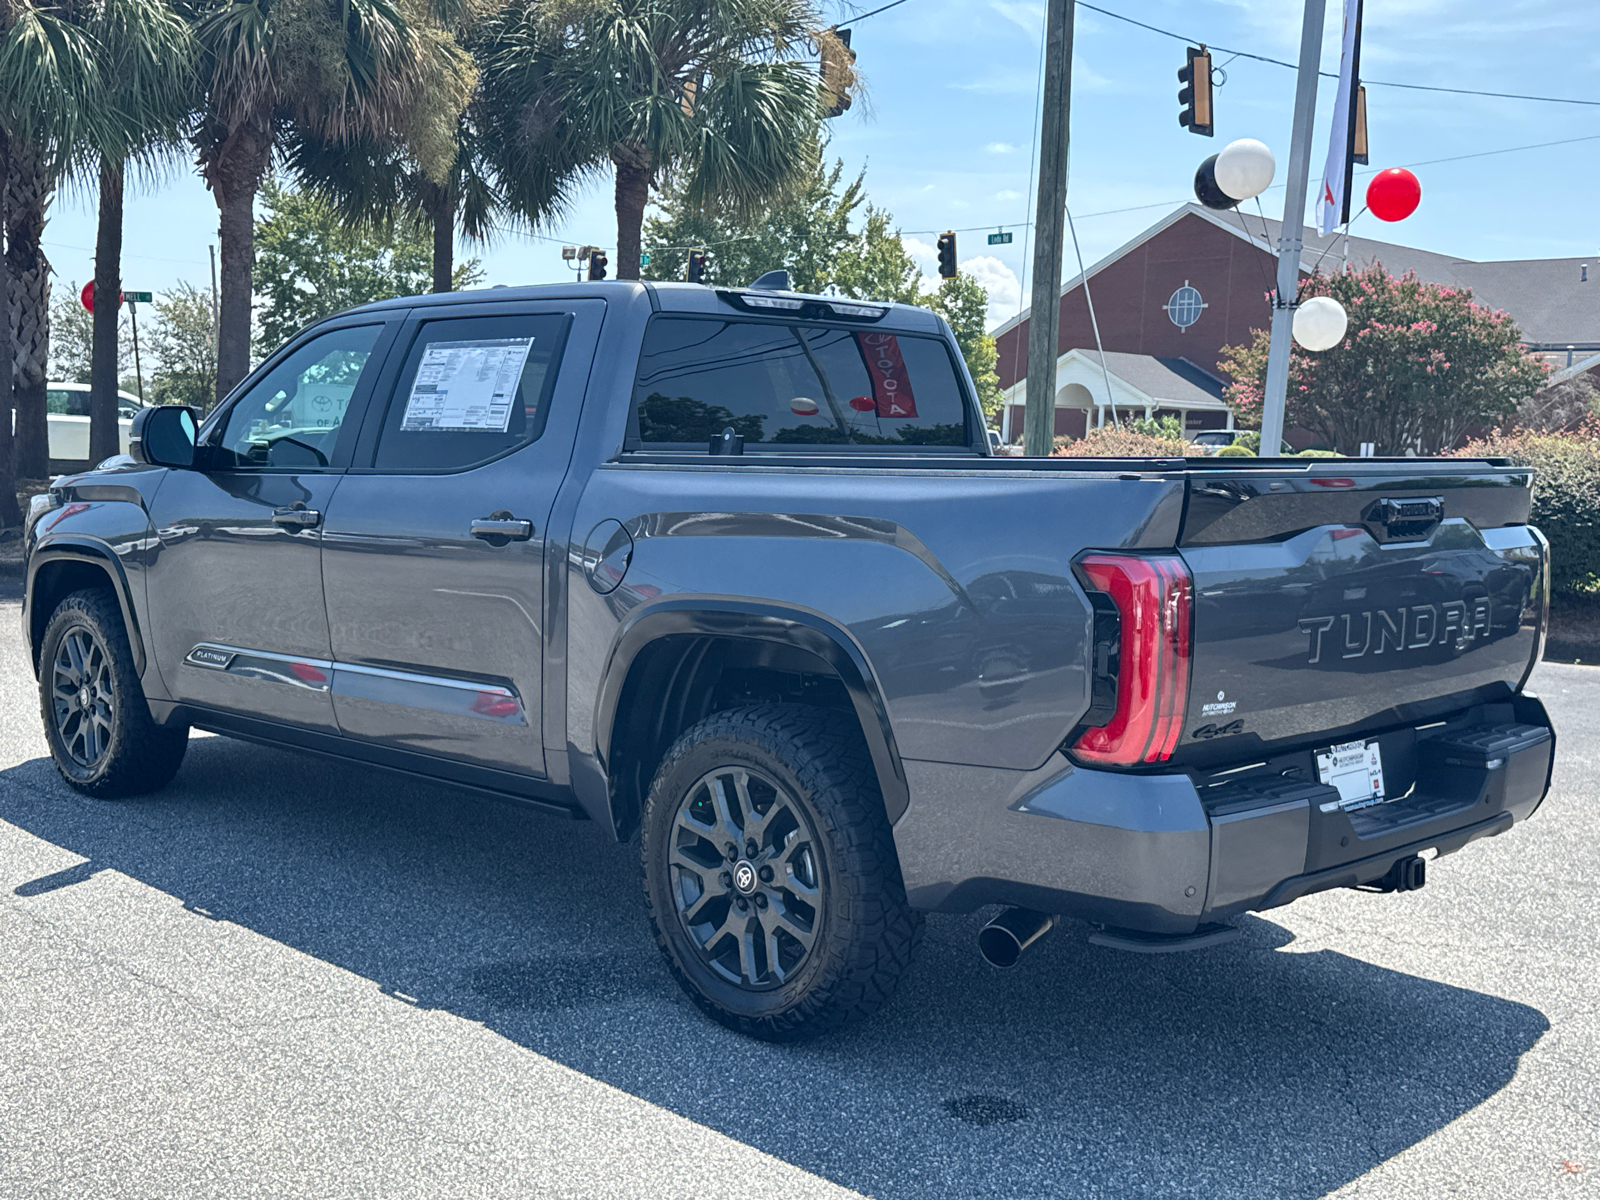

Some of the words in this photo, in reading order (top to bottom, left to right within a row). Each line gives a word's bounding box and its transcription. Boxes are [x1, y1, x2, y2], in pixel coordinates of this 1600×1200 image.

[876, 345, 908, 415] TOYOTA
[317, 419, 330, 427] OF
[1298, 596, 1492, 664] TUNDRA
[196, 650, 227, 662] PLATINUM
[1202, 701, 1237, 711] HUTCHINSON
